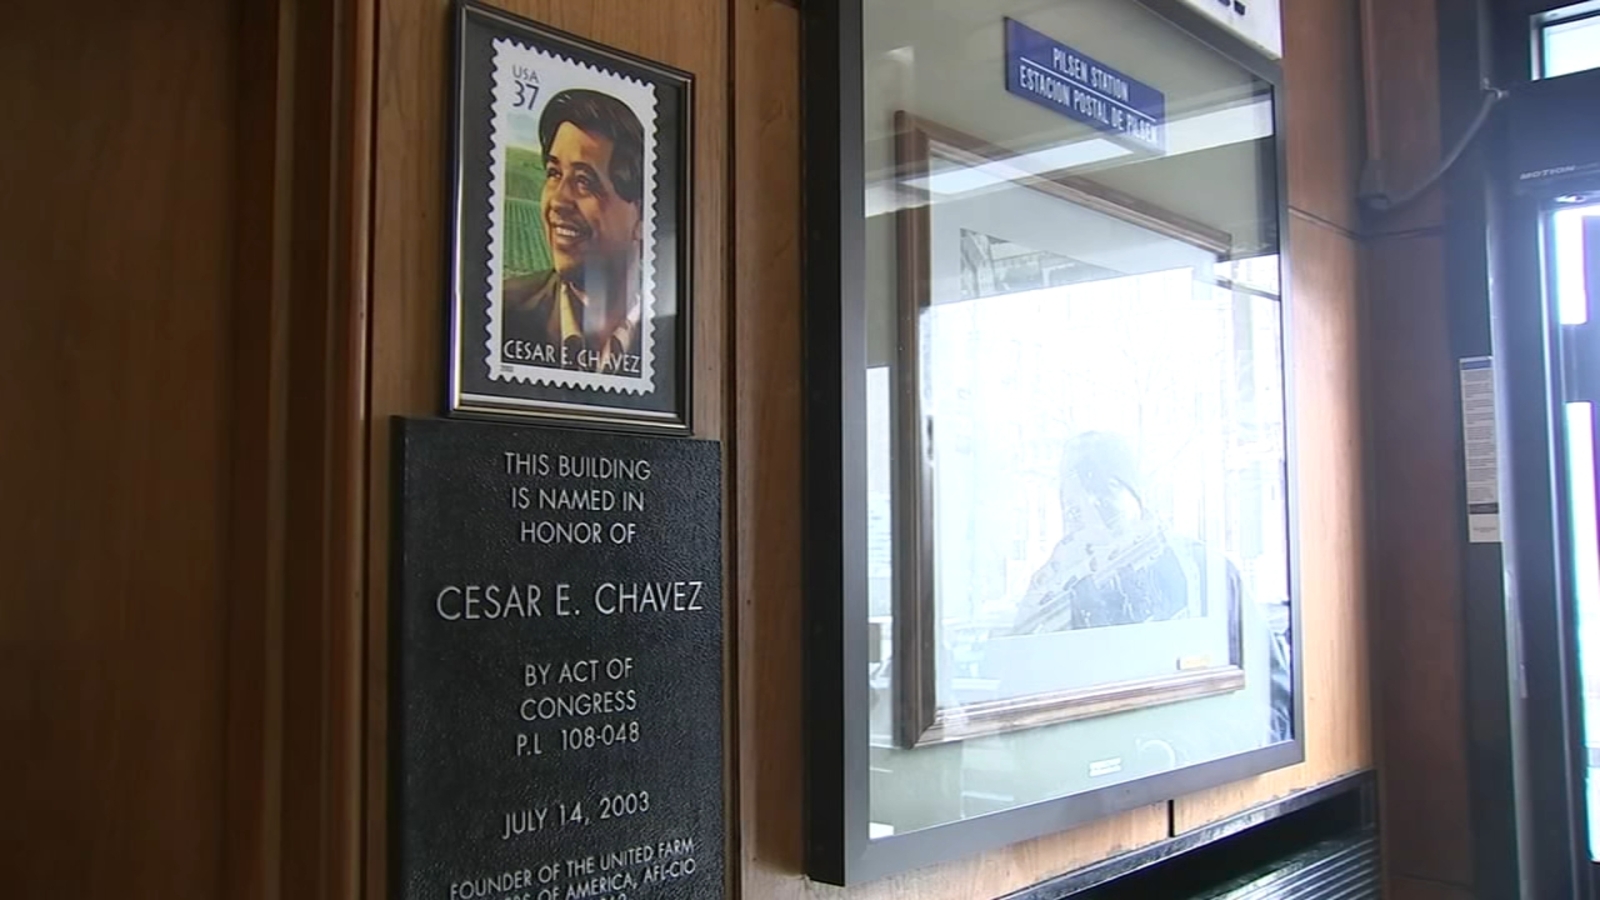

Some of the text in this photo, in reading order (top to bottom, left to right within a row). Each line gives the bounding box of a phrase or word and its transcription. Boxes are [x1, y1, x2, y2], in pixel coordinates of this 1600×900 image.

[512, 65, 539, 83] USA
[1053, 47, 1129, 102] PILSEN STATION
[512, 79, 539, 110] 37
[1019, 64, 1157, 142] ESTACION POSTAL DE PILSEN
[1519, 164, 1575, 180] MOTION
[503, 339, 641, 374] CESAR E. CHAVEZ
[504, 451, 651, 480] THIS BUILDING
[511, 486, 645, 512] IS NAMED IN
[520, 520, 636, 544] HONOR OF
[436, 580, 704, 621] CESAR E. CHAVEZ
[524, 657, 634, 687] BY ACT OF
[519, 689, 638, 722] CONGRESS
[560, 721, 641, 751] 108-048
[502, 790, 651, 841] JULY 14, 2003
[449, 868, 533, 900] FOUNDER
[538, 863, 561, 884] OF
[566, 856, 596, 878] THE
[600, 845, 654, 871] UNITED
[657, 837, 695, 859] FARM
[537, 858, 697, 900] OF AMERICA, AFL-CIO
